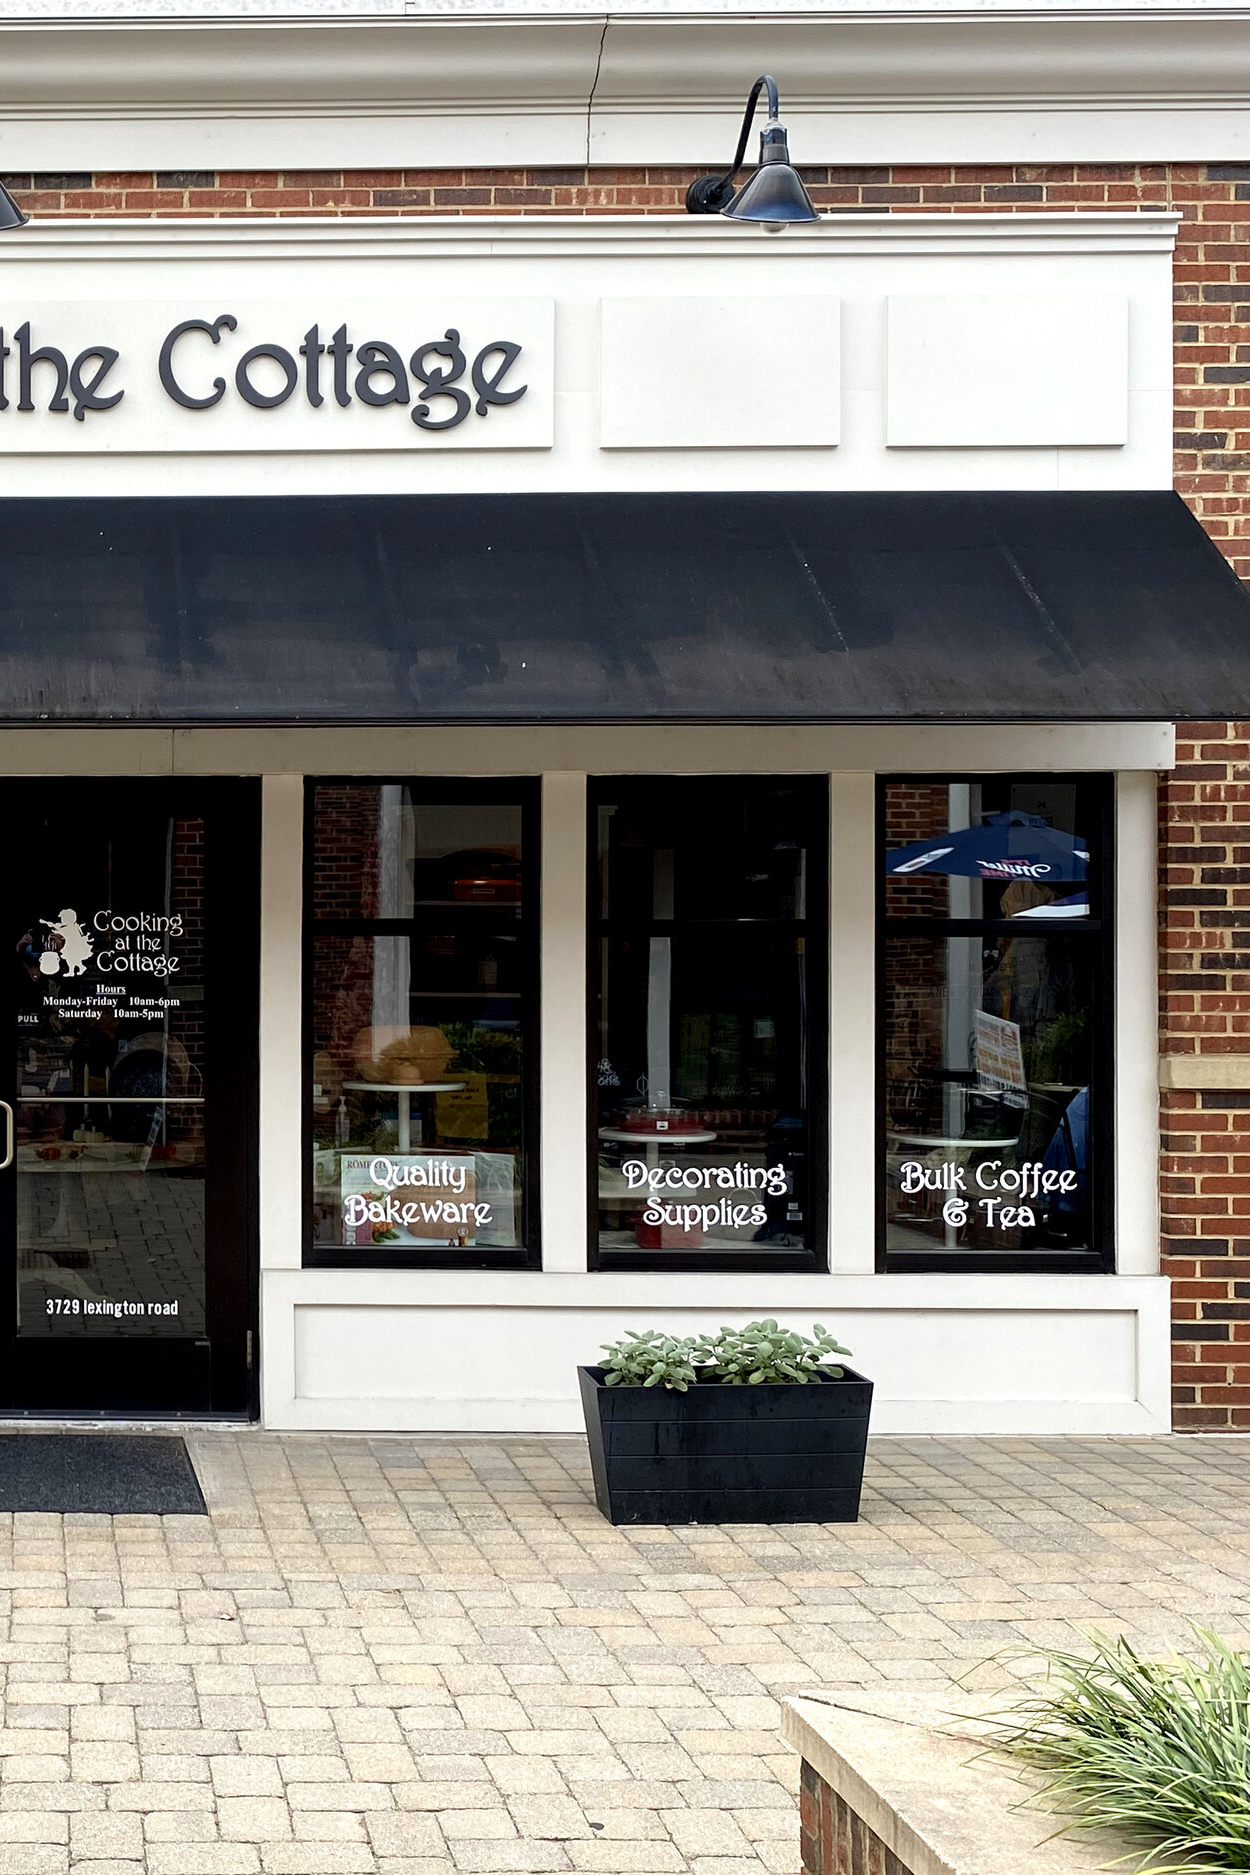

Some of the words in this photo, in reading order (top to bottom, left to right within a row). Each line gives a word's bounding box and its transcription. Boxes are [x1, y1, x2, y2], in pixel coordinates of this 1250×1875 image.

[159, 315, 527, 432] Cottage
[94, 910, 183, 937] Cooking
[116, 936, 129, 949] at
[136, 935, 161, 951] the
[97, 951, 179, 976] Cottage
[43, 996, 117, 1007] Monday-Friday
[130, 996, 180, 1007] 10am-6pm
[96, 984, 126, 994] Hours
[18, 1015, 39, 1023] PULL
[58, 1008, 102, 1019] Saturday
[114, 1008, 163, 1019] 10am-5pm
[370, 1158, 466, 1193] Quality
[623, 1161, 787, 1195] Decorating
[901, 1162, 966, 1193] Bulk
[976, 1161, 1077, 1199] Coffee
[344, 1194, 492, 1226] Bakeware
[644, 1197, 767, 1232] Supplies
[943, 1198, 968, 1226] &
[979, 1195, 1035, 1230] Tea
[46, 1299, 80, 1314] 3729
[83, 1299, 145, 1318] lexington
[147, 1299, 179, 1315] road
